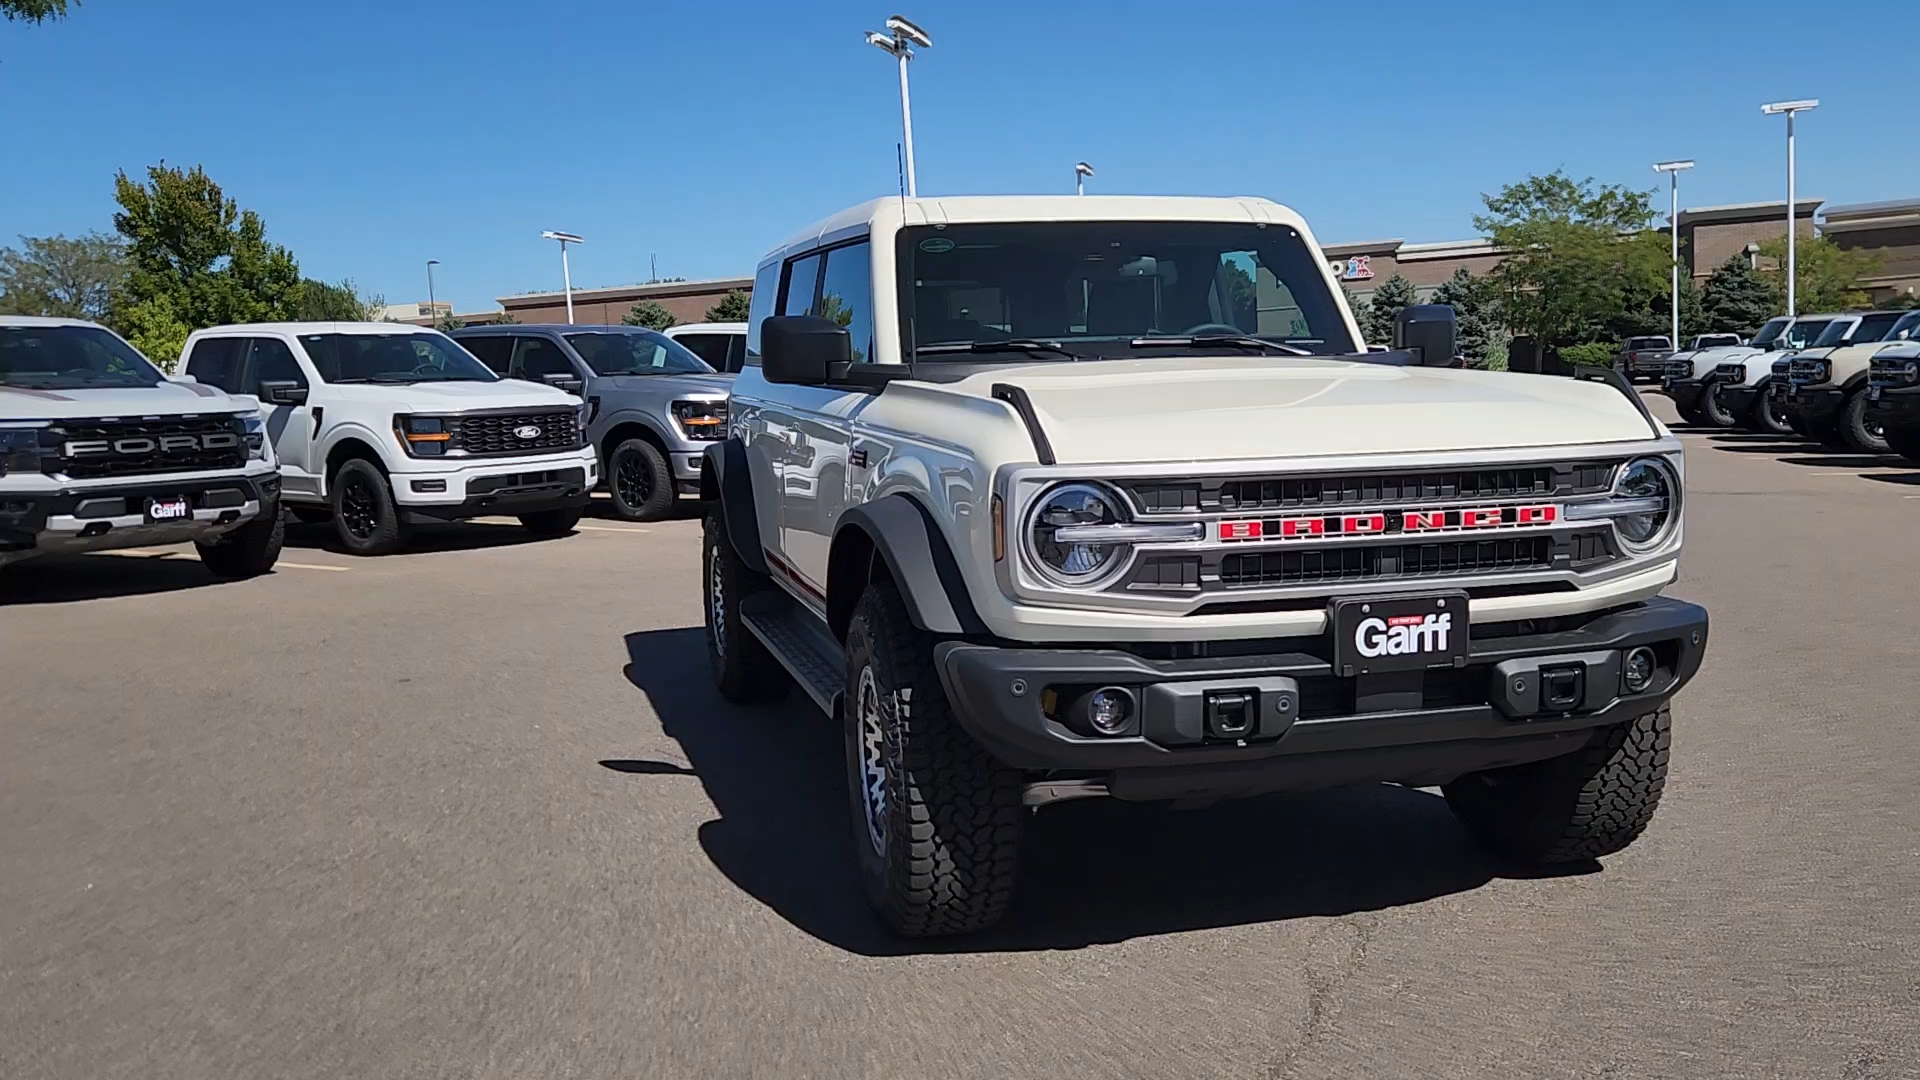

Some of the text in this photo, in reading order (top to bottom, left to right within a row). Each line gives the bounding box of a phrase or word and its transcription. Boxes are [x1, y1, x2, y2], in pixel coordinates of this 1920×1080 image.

[65, 433, 239, 457] FORD
[150, 501, 186, 518] Garff
[1218, 504, 1557, 541] BRONCO
[1355, 612, 1451, 658] Garff
